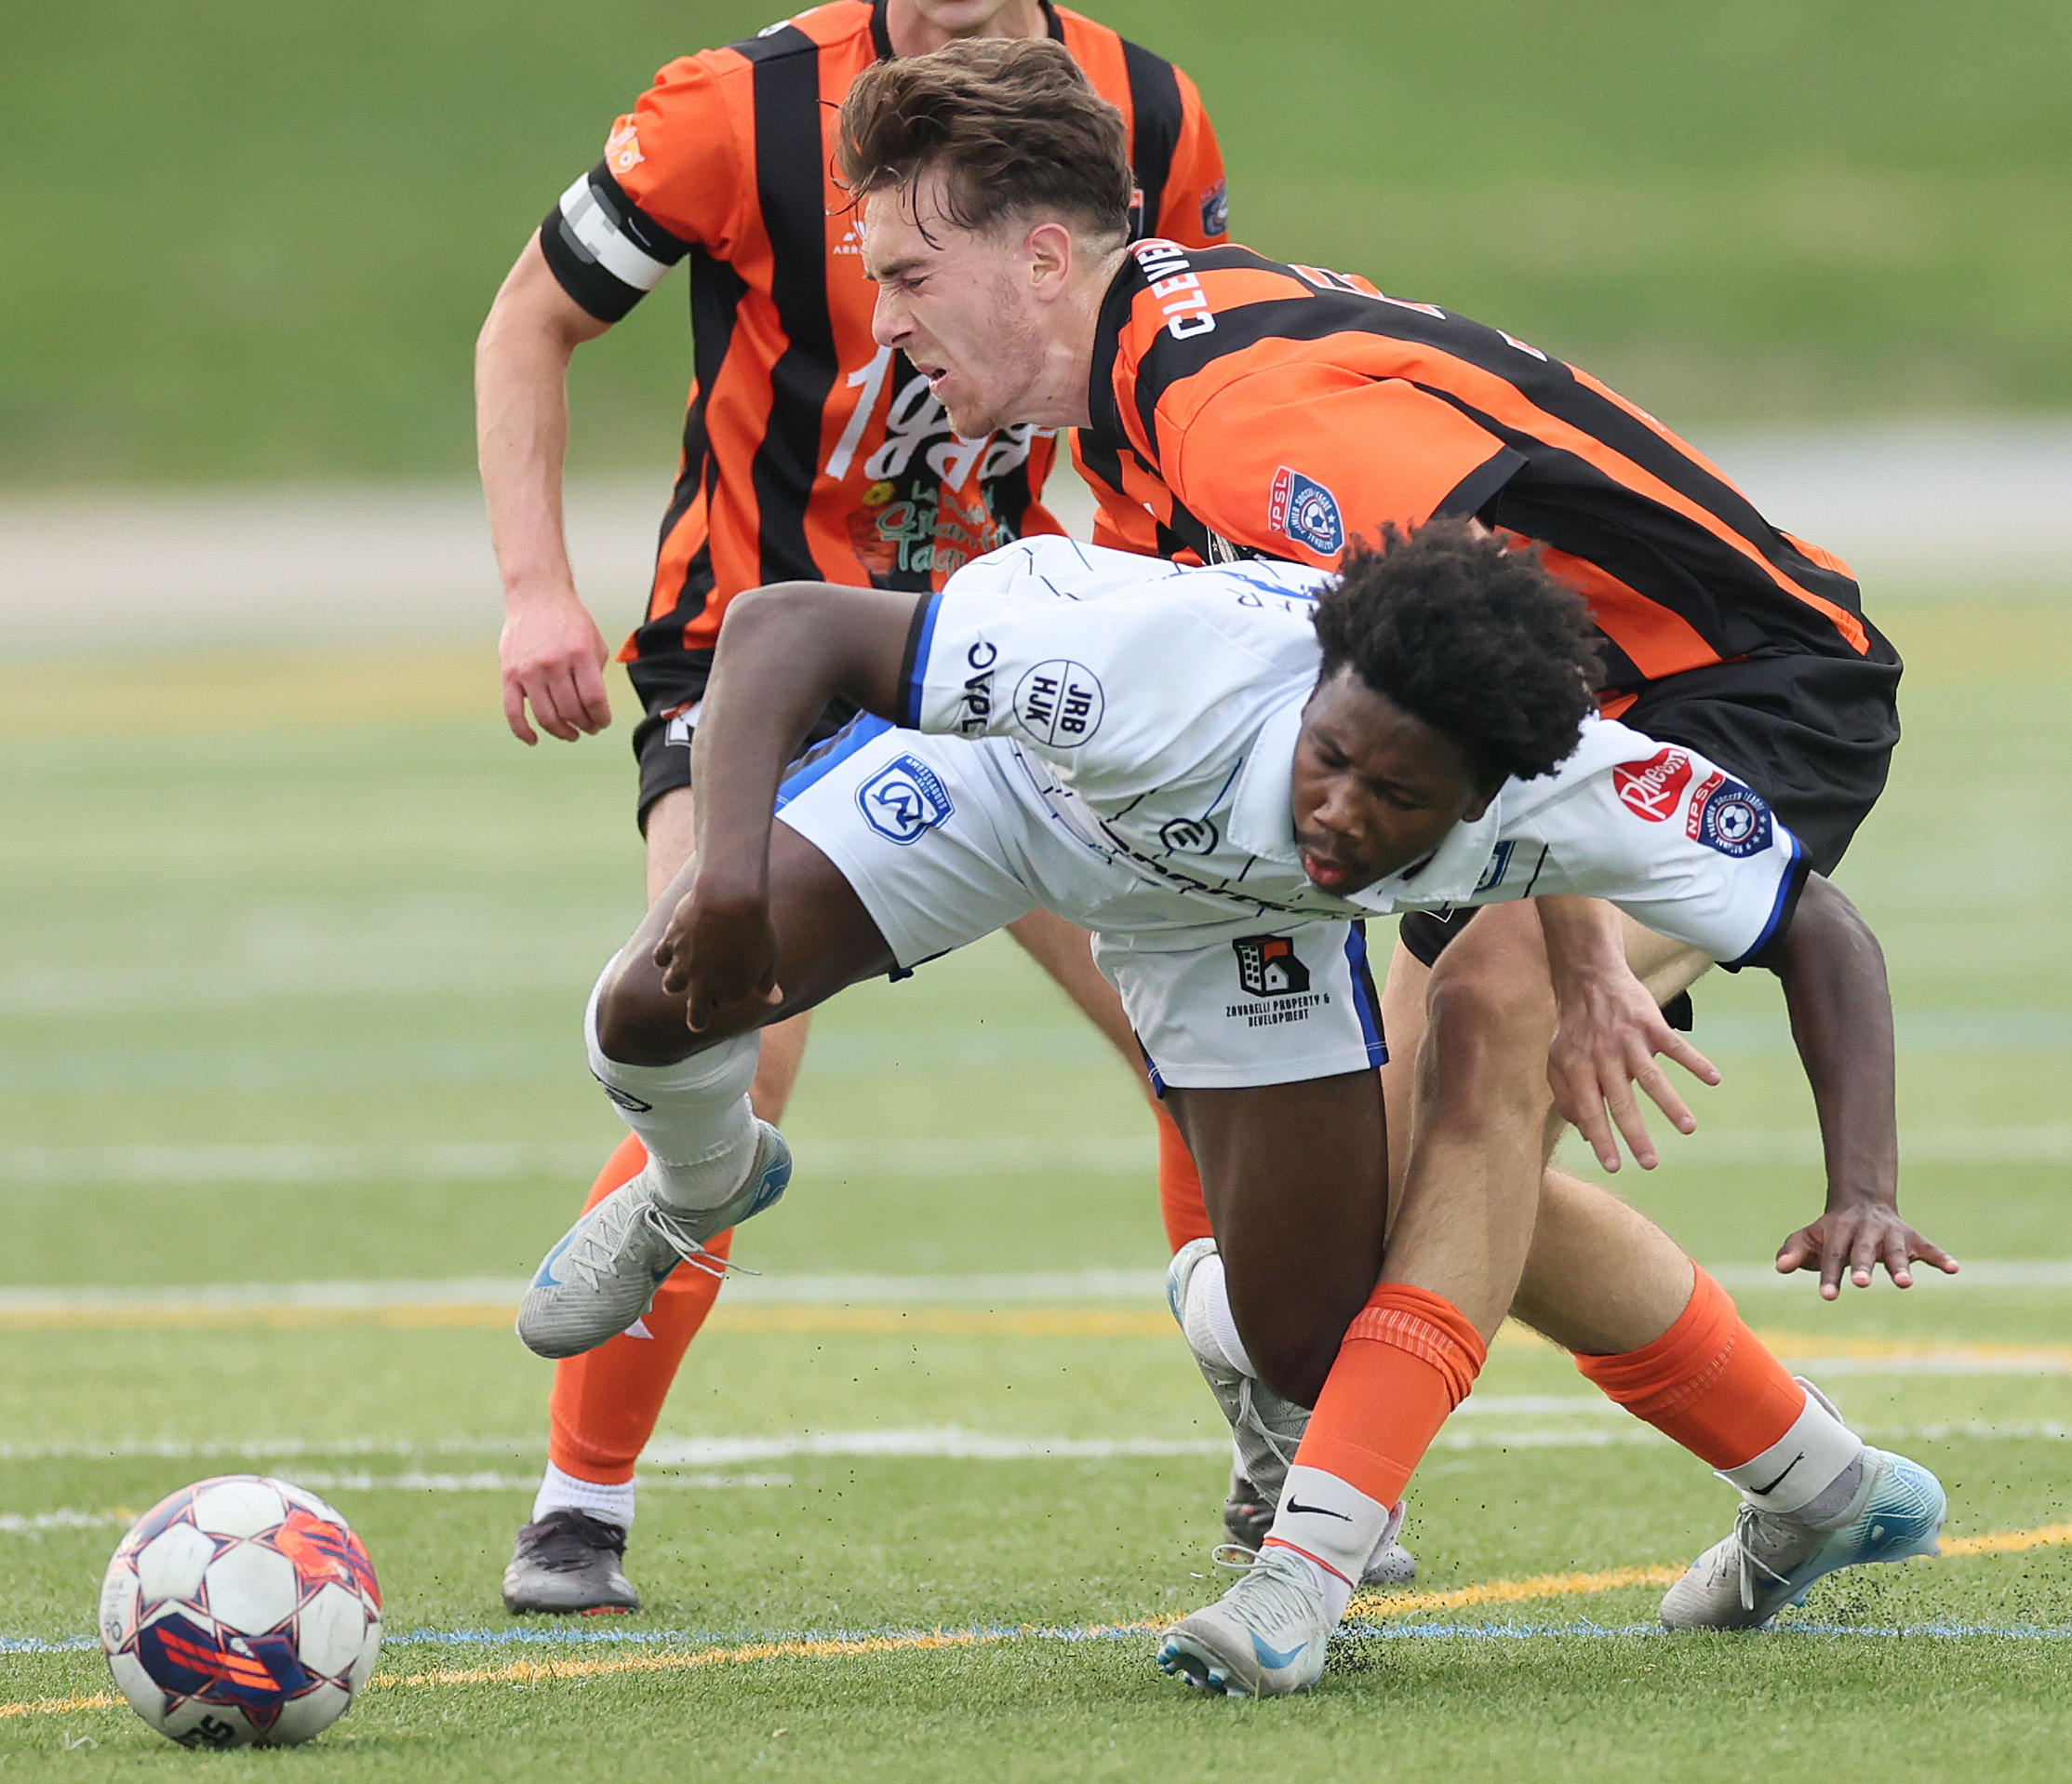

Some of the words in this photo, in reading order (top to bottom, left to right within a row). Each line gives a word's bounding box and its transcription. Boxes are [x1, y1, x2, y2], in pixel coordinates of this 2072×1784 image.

[1025, 676, 1059, 727] HJK
[1060, 683, 1093, 735] JRB
[1612, 748, 1689, 822] Rheem
[1687, 776, 1722, 836] NPSL
[1225, 1001, 1271, 1018] ZAVARELLI
[1273, 994, 1320, 1013] PROPERTY
[1248, 1008, 1310, 1028] DEVELOPMENT
